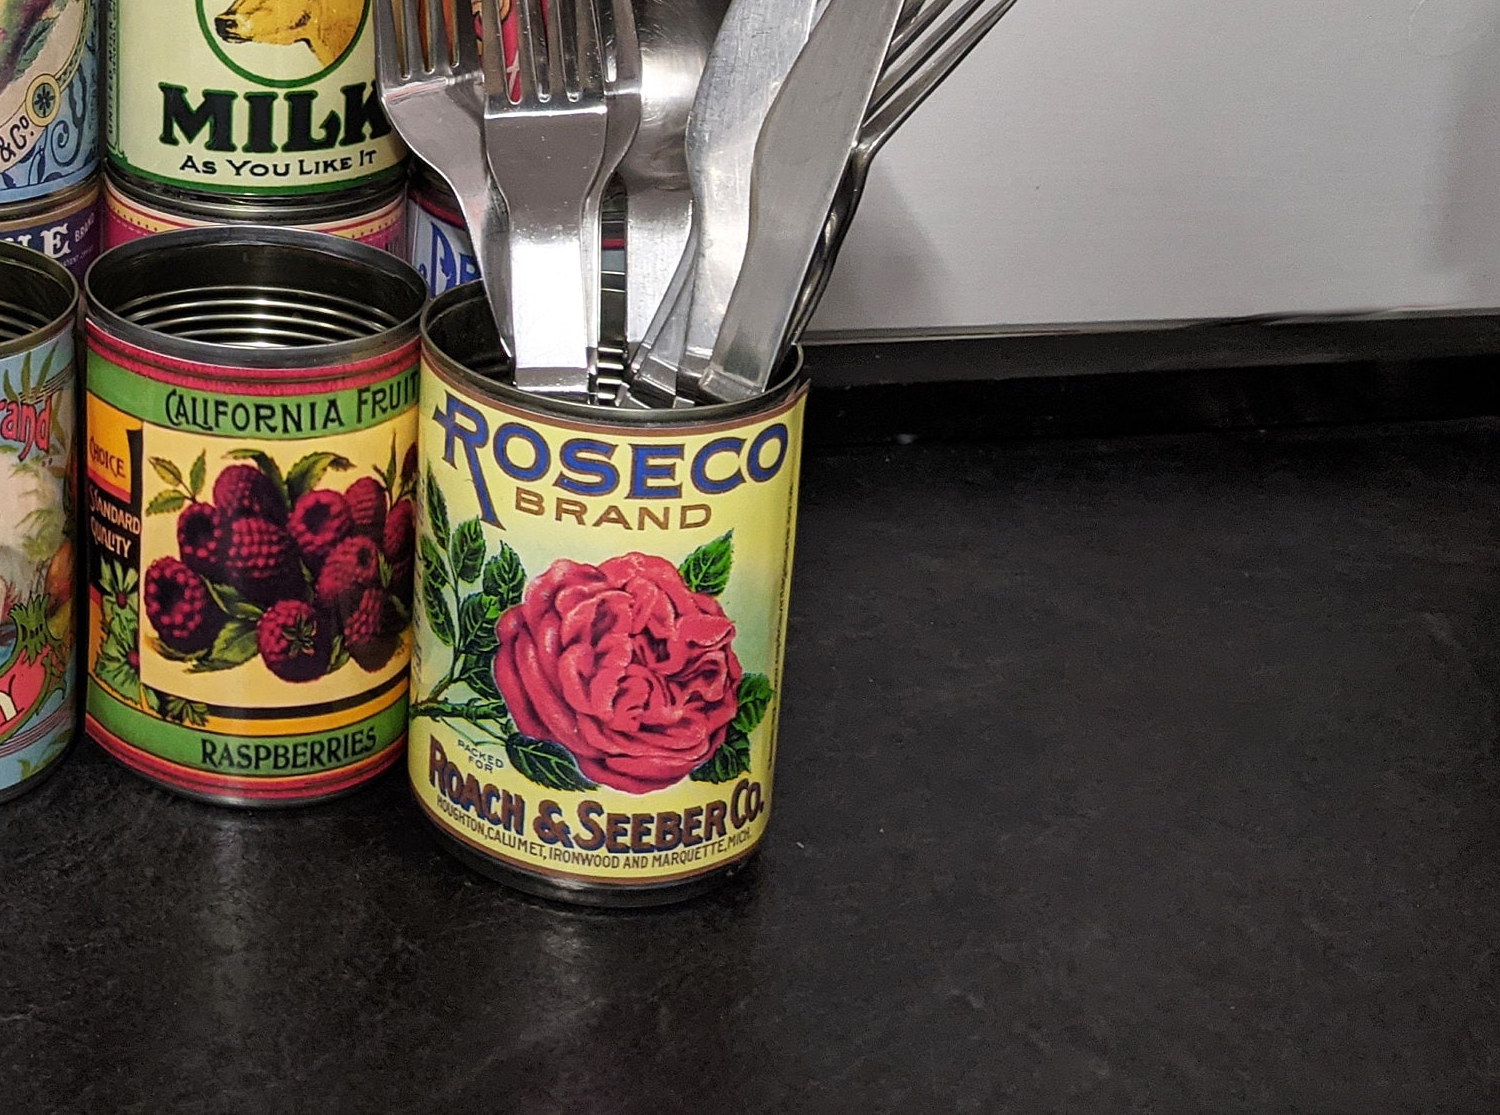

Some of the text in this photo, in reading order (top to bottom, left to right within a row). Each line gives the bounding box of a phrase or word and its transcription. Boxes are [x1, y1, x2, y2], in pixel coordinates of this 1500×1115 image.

[158, 79, 392, 155] MILK
[179, 149, 378, 179] AS YOU LIKE IT
[164, 388, 344, 434] CALIFORNIA
[89, 436, 126, 479] CHOICE
[432, 391, 789, 531] ROSECO
[514, 486, 712, 531] BRAND
[200, 726, 377, 771] RASPBERRIES
[457, 739, 505, 770] PACKED
[468, 756, 493, 773] FOR
[429, 733, 765, 856] ROACH & SEEBER CO.
[550, 847, 620, 869] IRONWOOD
[623, 856, 648, 869] AND
